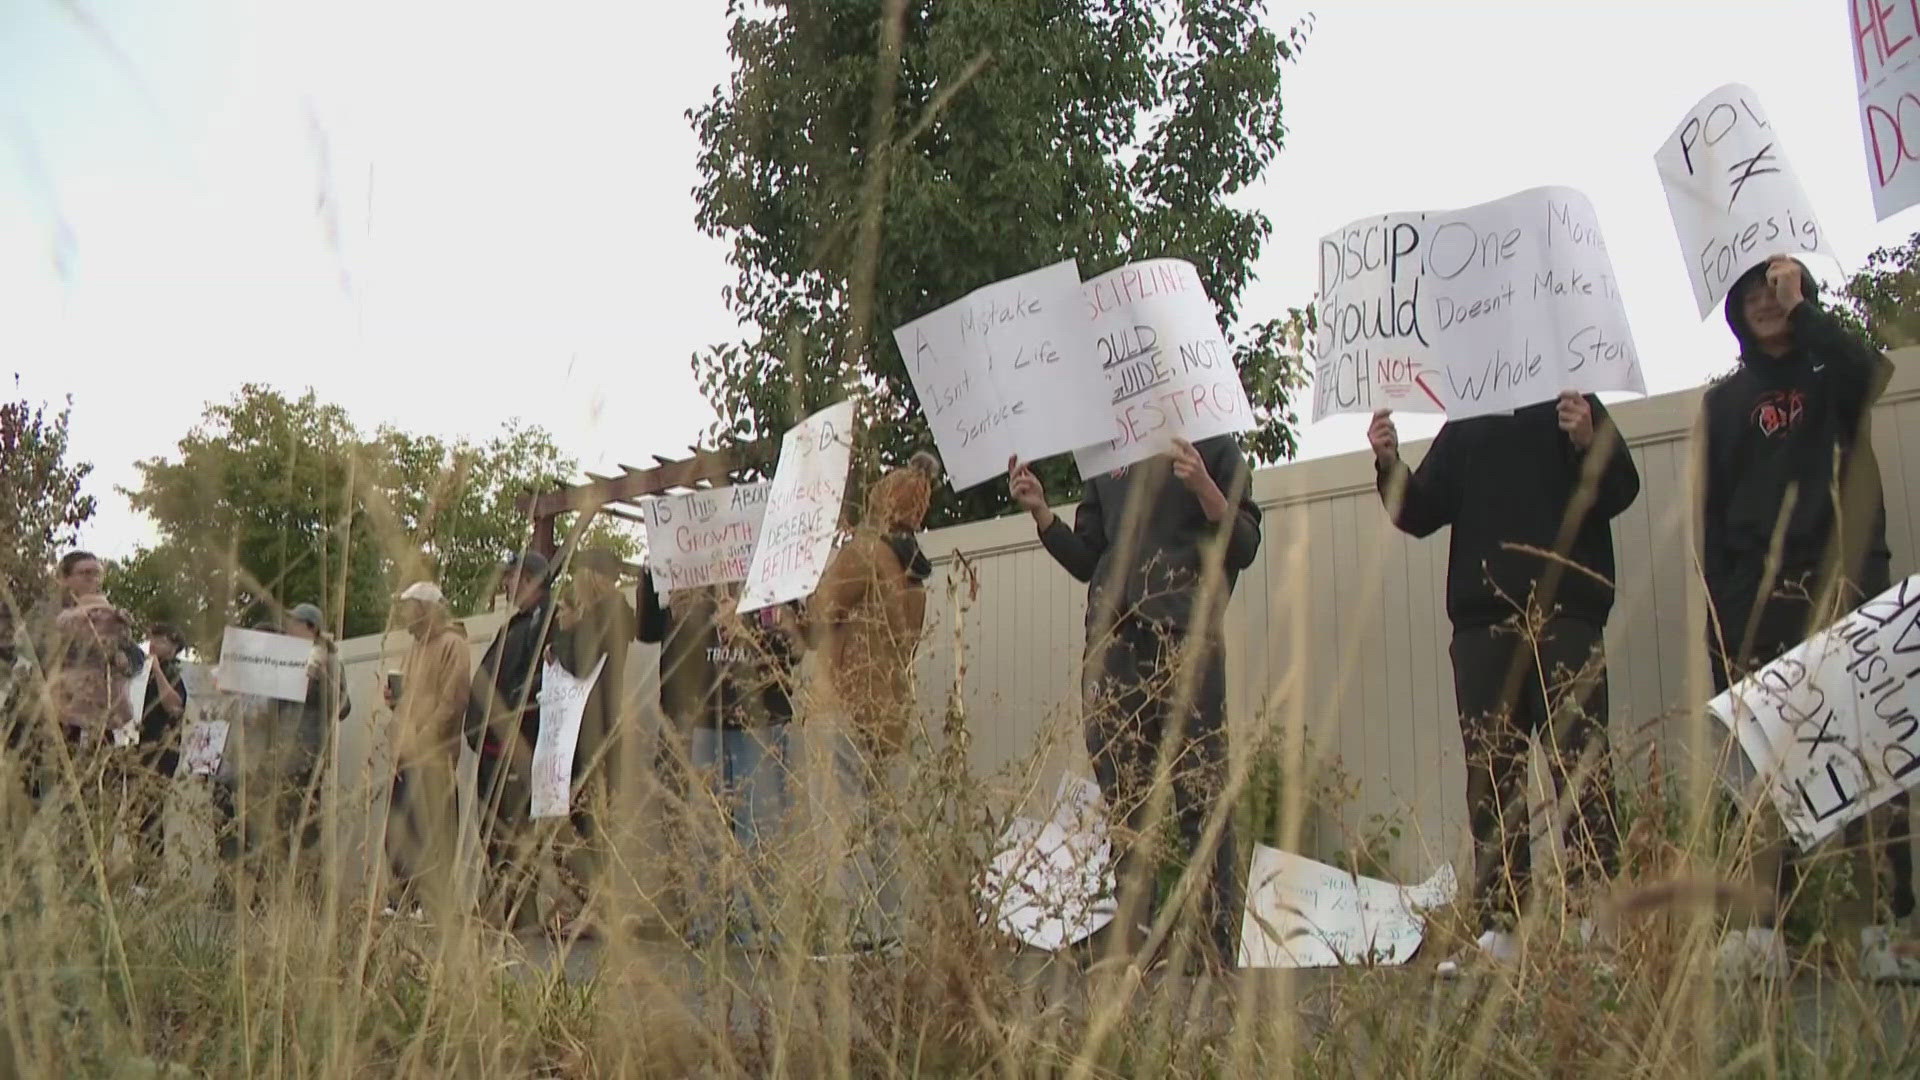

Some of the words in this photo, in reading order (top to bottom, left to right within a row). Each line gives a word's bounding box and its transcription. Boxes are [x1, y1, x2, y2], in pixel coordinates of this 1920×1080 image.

[1428, 221, 1522, 279] One
[1533, 268, 1593, 299] Make
[1179, 338, 1222, 374] NOT
[1317, 348, 1371, 415] TEACH
[1447, 338, 1542, 401] Whole
